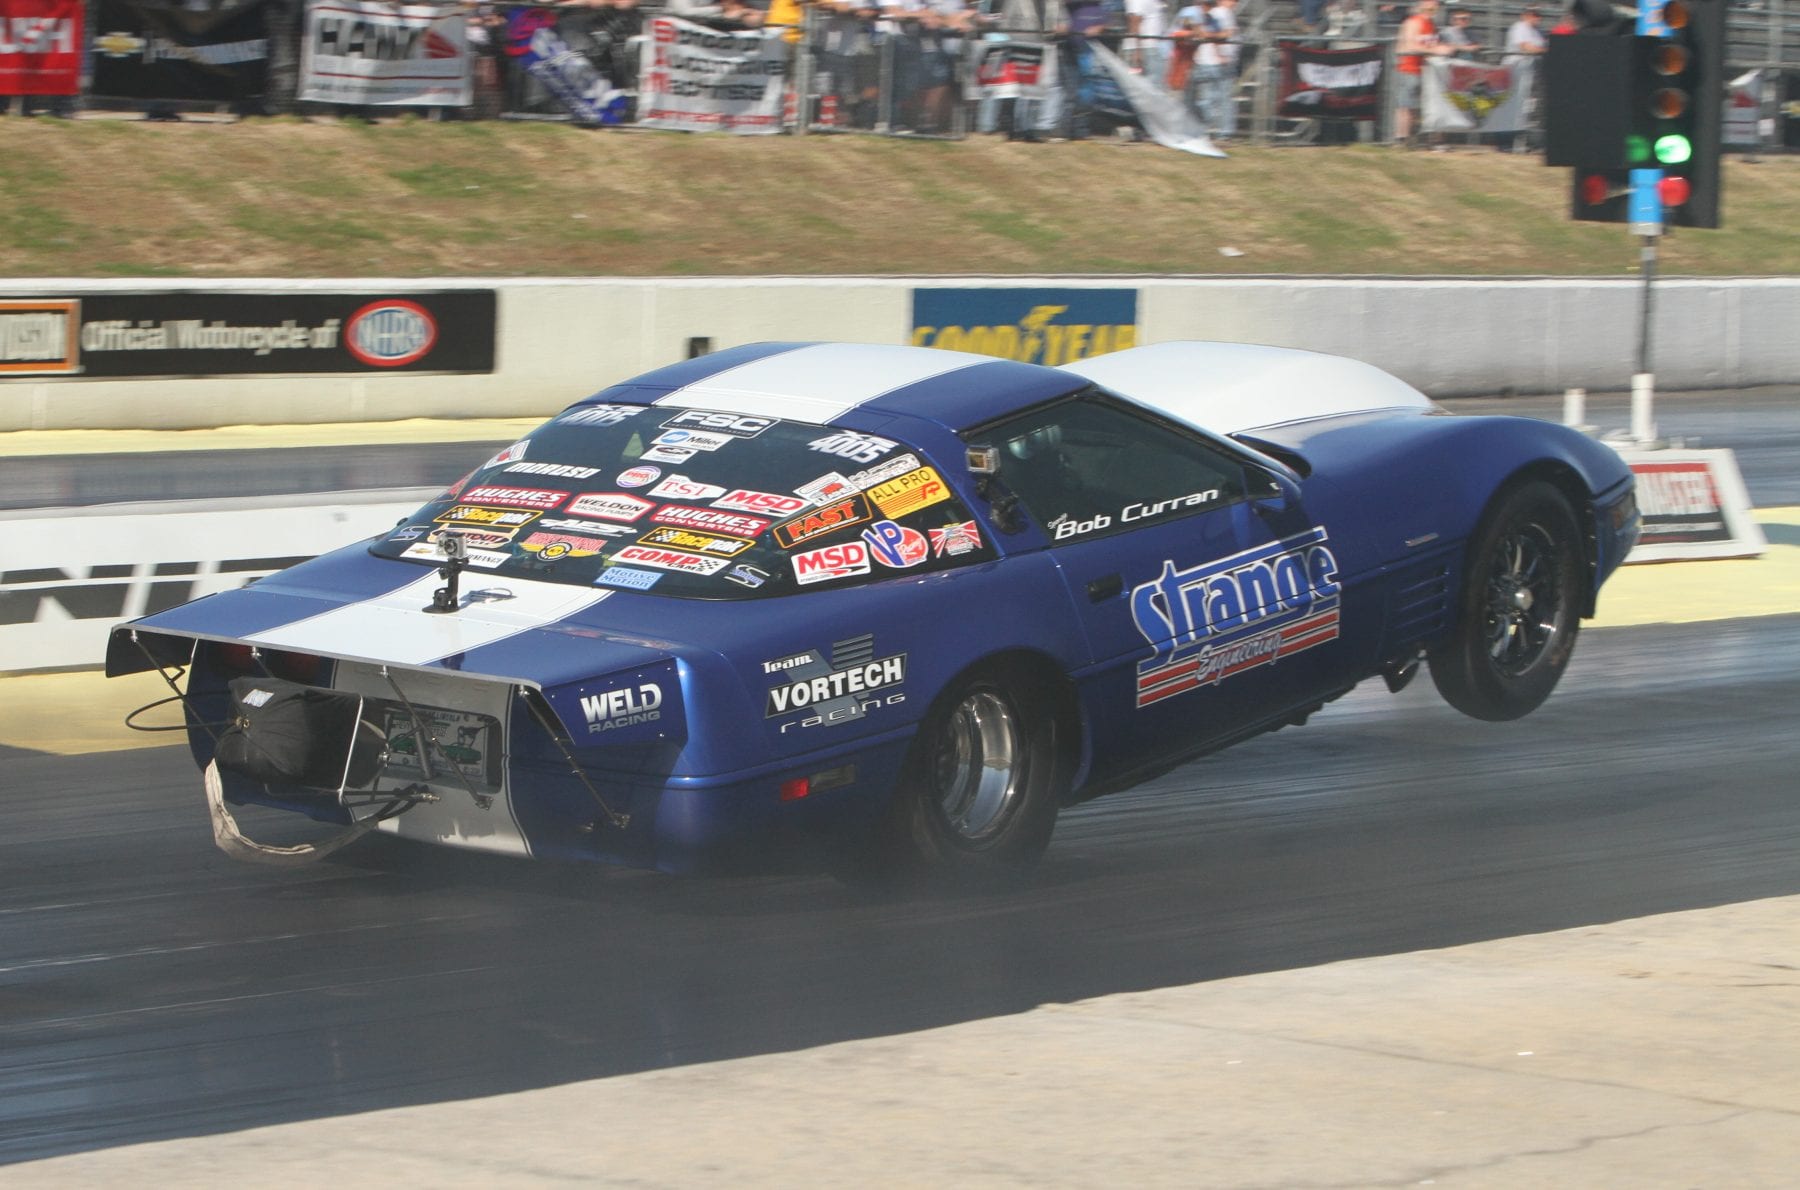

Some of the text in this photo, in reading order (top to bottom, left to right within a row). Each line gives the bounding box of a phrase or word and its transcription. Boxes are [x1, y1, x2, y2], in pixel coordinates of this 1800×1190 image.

[82, 320, 172, 352] Official
[176, 319, 307, 357] Motorcycle
[310, 318, 340, 350] of
[672, 411, 771, 432] FSC
[806, 432, 891, 464] 4005
[466, 487, 567, 503] HUGHES
[872, 484, 900, 501] ALL
[900, 470, 931, 489] PRO
[463, 497, 554, 508] CONVERTERS
[578, 498, 645, 512] WELDON
[724, 492, 804, 510] MSD
[655, 516, 755, 535] CONVERTERS
[657, 506, 768, 530] HUGHES
[786, 500, 857, 539] FAST
[1054, 514, 1111, 540] Bob
[1121, 489, 1219, 522] Curran
[863, 521, 905, 566] VP
[620, 548, 702, 565] COMP
[667, 563, 705, 572] CAMS
[798, 544, 865, 575] MSD
[600, 574, 649, 588] Motion
[607, 568, 656, 580] Motive
[1131, 525, 1342, 668] Strange
[760, 653, 814, 674] Team
[1195, 630, 1283, 686] Engineering
[770, 657, 903, 712] VORTECH
[579, 683, 662, 724] WELD
[780, 693, 906, 733] racing
[588, 710, 661, 734] RACING
